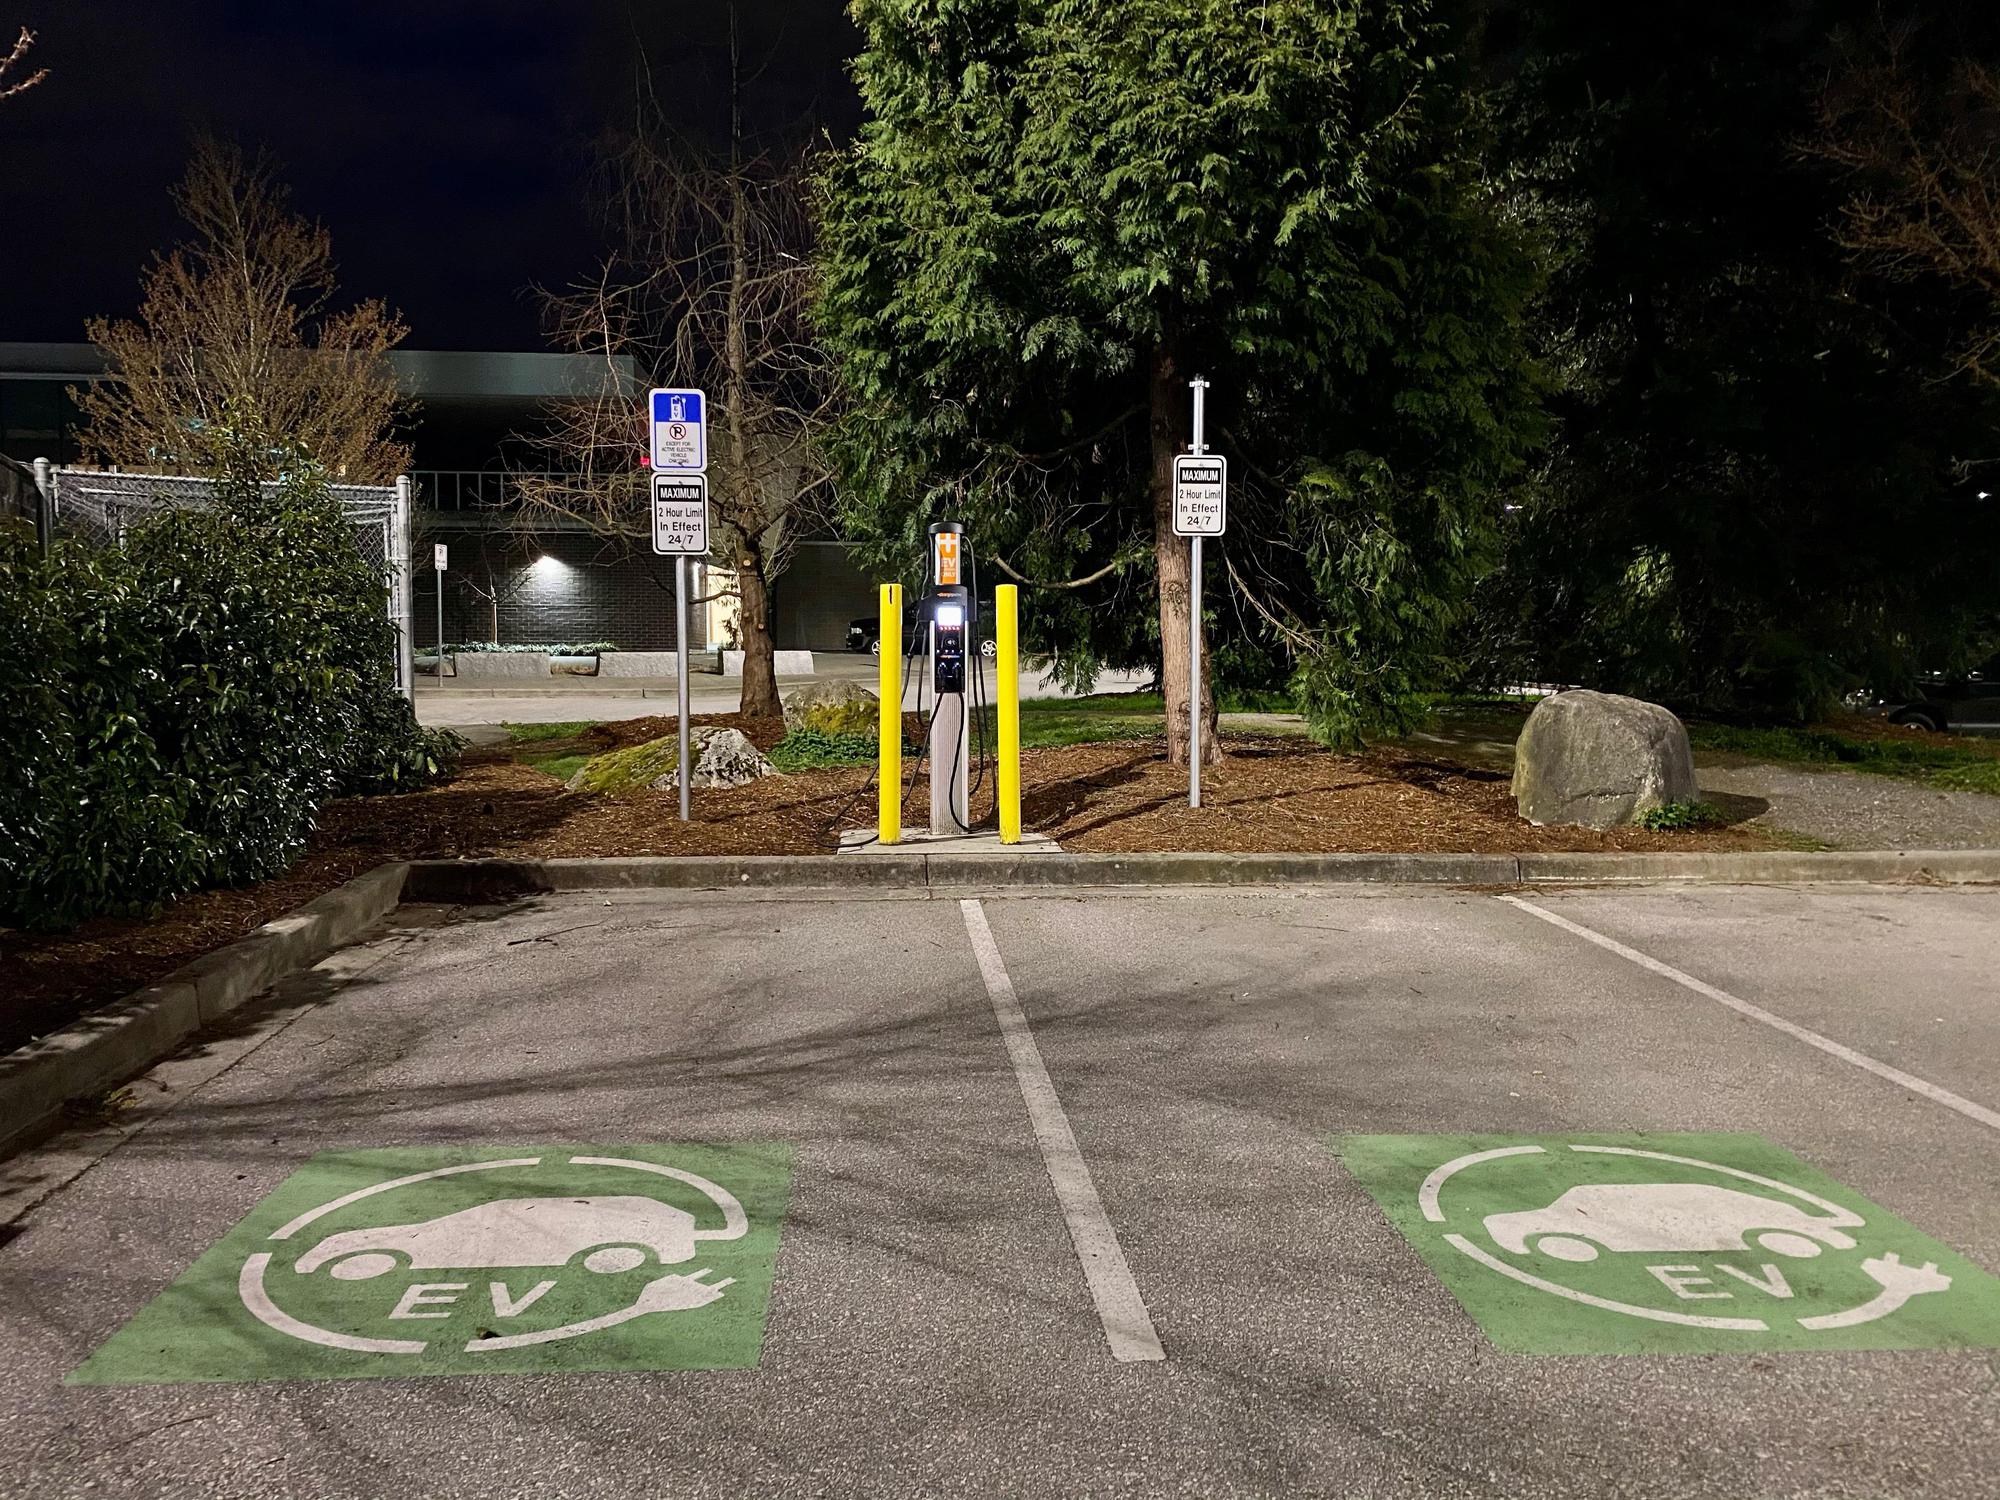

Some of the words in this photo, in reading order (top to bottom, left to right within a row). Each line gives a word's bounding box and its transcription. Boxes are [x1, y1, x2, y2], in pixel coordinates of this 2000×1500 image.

[1182, 470, 1218, 481] MAXIMUM
[660, 487, 699, 499] MAXIMUM
[1179, 489, 1184, 499] 2
[1186, 489, 1202, 499] Hour
[1205, 489, 1220, 499] Limit
[658, 507, 663, 517] 2
[666, 507, 682, 517] Hour
[686, 507, 702, 517] Limit
[1180, 503, 1188, 512] In
[1192, 503, 1218, 513] Effect
[660, 521, 668, 531] In
[672, 521, 701, 531] Effect
[1187, 515, 1211, 526] 24/7
[668, 534, 694, 545] 24/7
[941, 557, 956, 568] EV
[1645, 1264, 1794, 1299] EV
[388, 1281, 557, 1319] EV
